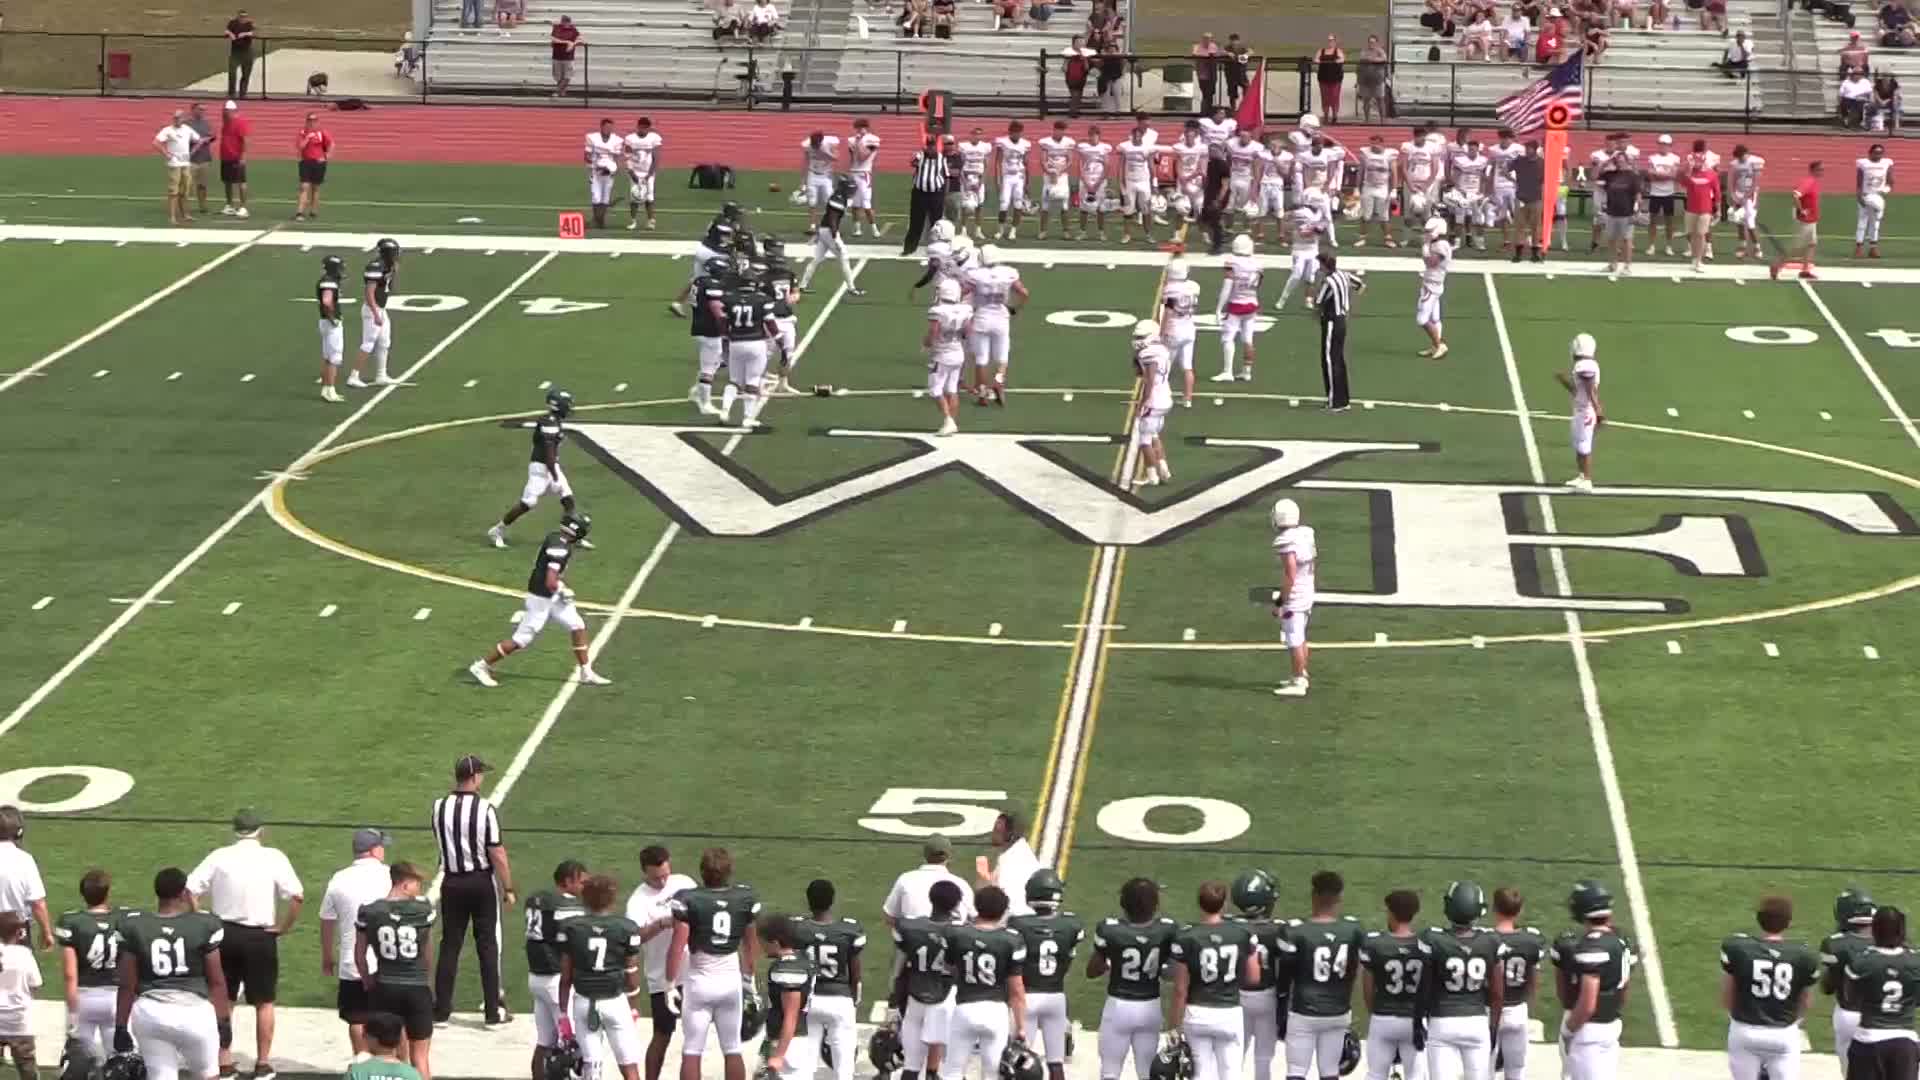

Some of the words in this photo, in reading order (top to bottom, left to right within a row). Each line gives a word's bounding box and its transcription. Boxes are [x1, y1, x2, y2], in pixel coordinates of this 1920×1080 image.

[562, 216, 581, 236] 40
[732, 305, 754, 327] 77
[377, 925, 418, 960] 88
[711, 910, 731, 944] 9
[86, 933, 119, 969] 41
[151, 937, 190, 976] 61
[588, 937, 608, 971] 7
[806, 944, 838, 978] 15
[1039, 939, 1059, 976] 6
[1122, 947, 1160, 981] 24
[1199, 943, 1239, 983] 87
[1313, 943, 1349, 982] 64
[1384, 959, 1423, 995] 33
[1751, 959, 1793, 1000] 58
[1881, 980, 1904, 1012] 2
